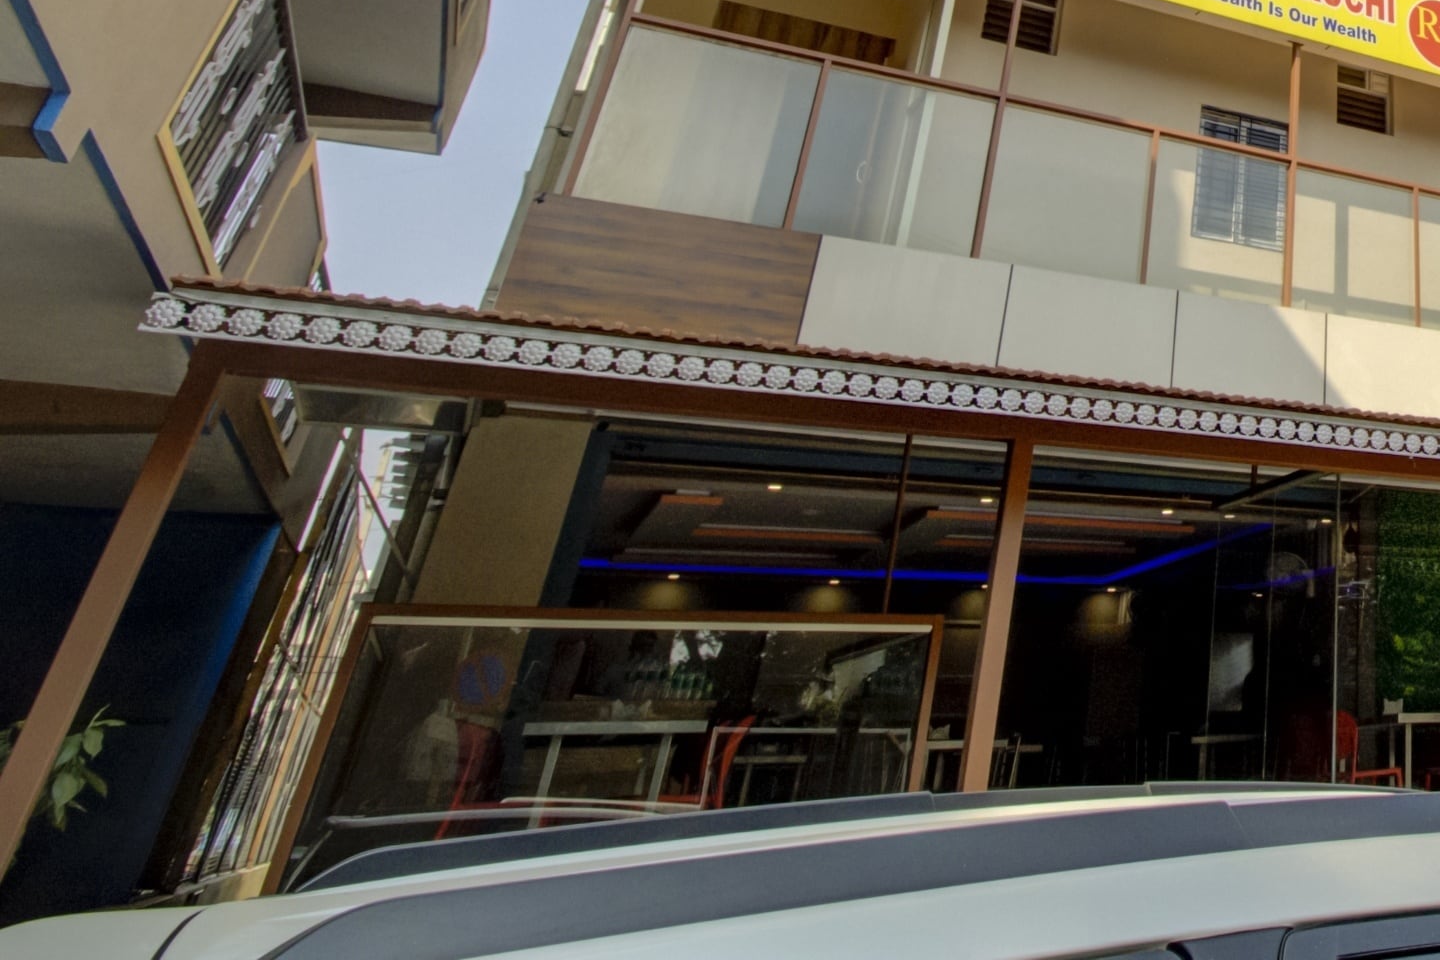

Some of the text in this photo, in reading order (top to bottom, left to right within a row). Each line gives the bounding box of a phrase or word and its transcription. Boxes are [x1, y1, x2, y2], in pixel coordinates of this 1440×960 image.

[1268, 1, 1283, 18] Is
[1289, 7, 1318, 27] Our
[1323, 16, 1377, 44] Wealth
